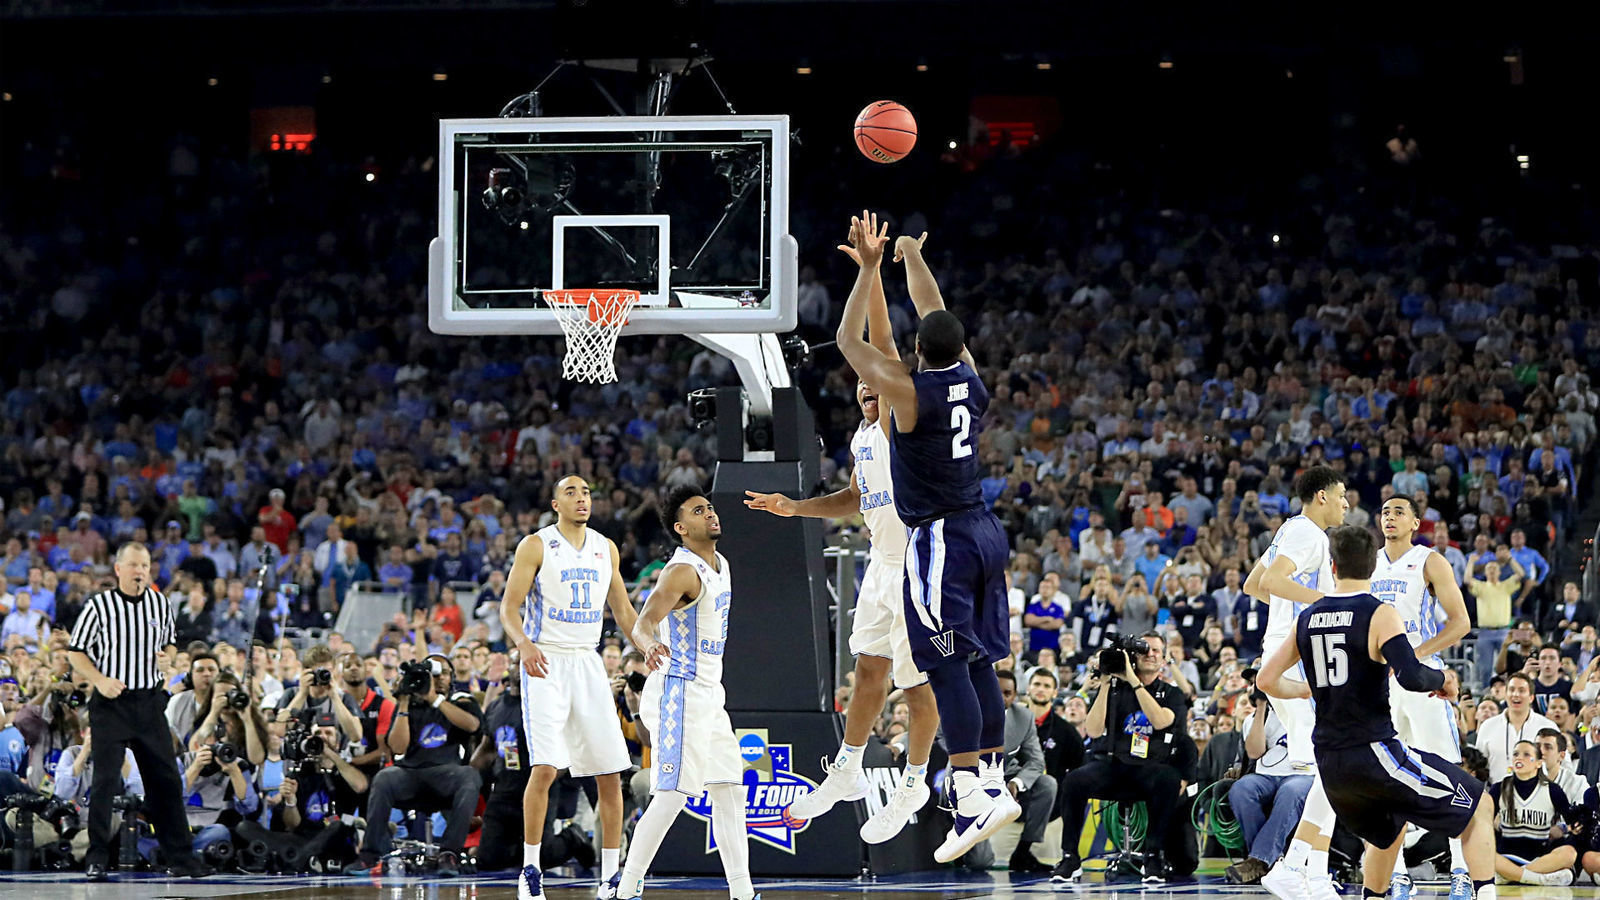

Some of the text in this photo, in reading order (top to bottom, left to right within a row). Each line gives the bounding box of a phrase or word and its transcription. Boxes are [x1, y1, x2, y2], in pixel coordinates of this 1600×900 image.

[951, 405, 973, 459] 2
[860, 490, 893, 511] LINA
[560, 567, 600, 583] NORTH
[1370, 579, 1408, 594] NORTH
[570, 582, 592, 609] 11
[548, 606, 602, 624] CAROLIN
[930, 630, 955, 657] V
[1310, 633, 1349, 688] 15
